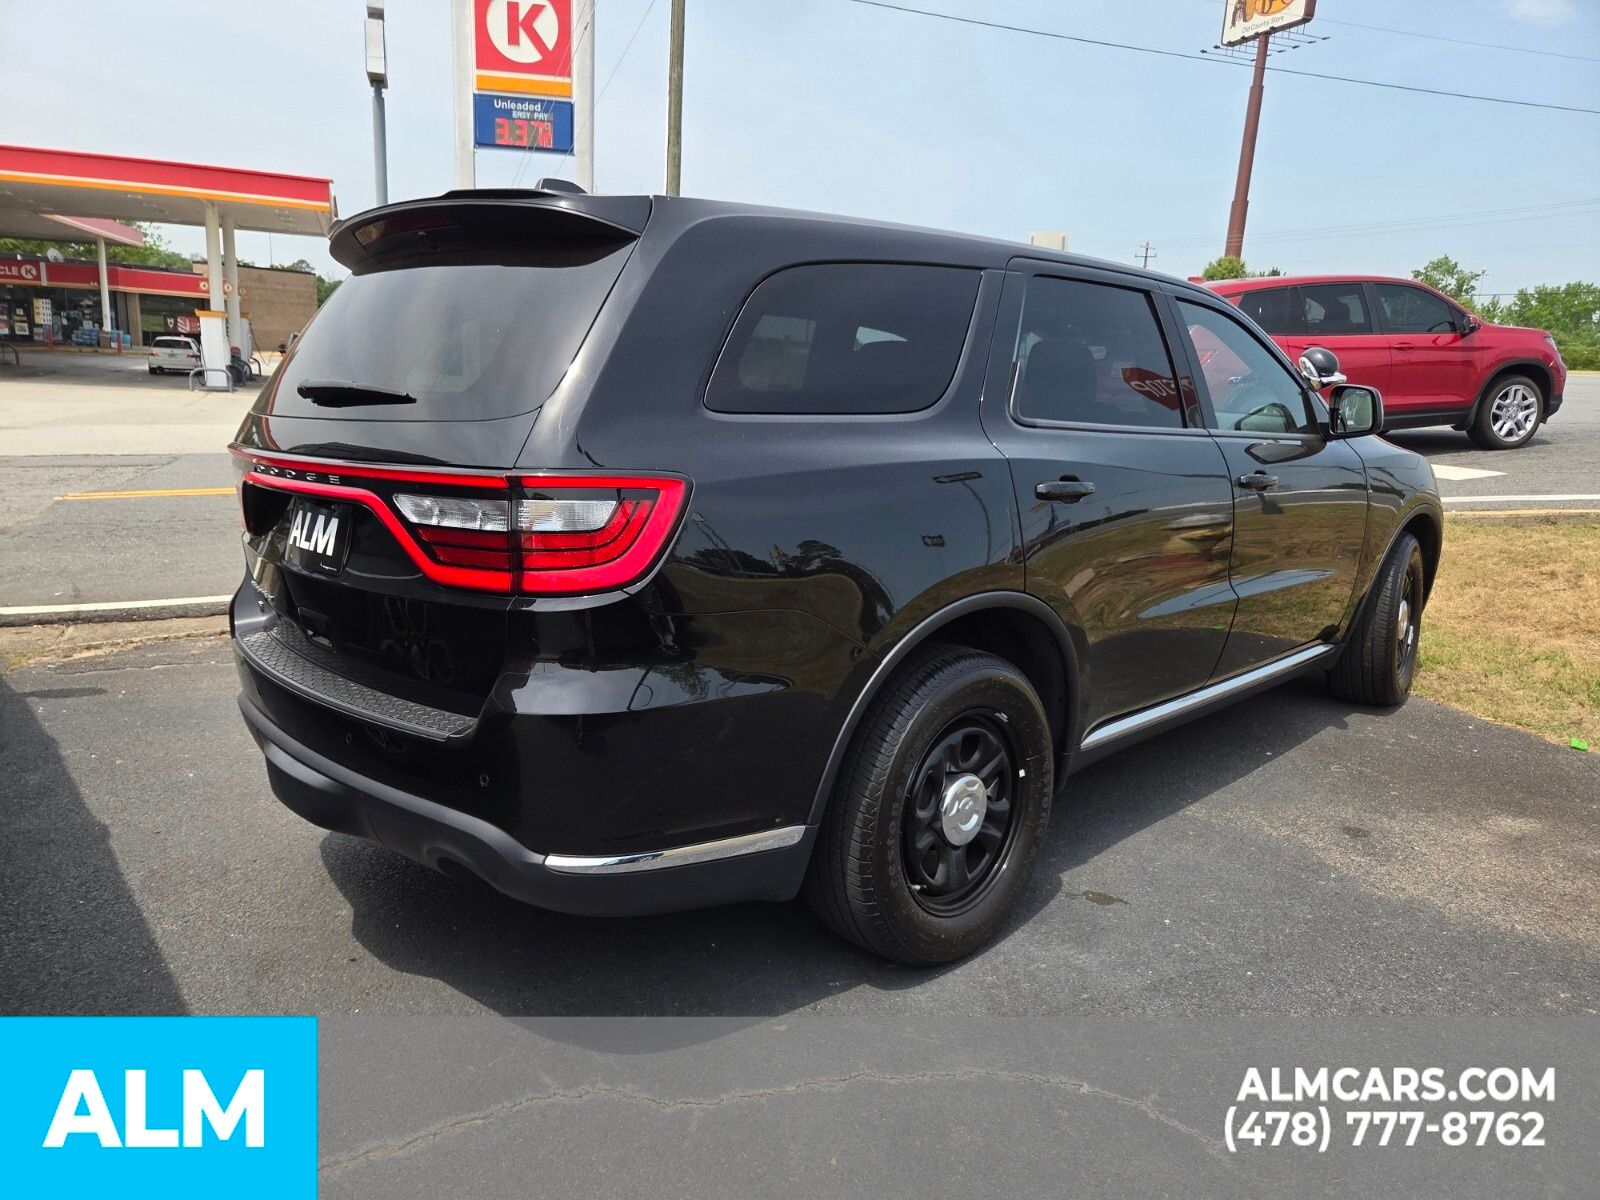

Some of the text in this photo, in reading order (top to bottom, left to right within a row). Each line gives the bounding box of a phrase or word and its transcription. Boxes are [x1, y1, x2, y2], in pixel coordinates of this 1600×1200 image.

[507, 1, 552, 58] K
[494, 98, 541, 112] Unleaded
[512, 110, 531, 119] EASY
[254, 465, 340, 484] DODGE
[289, 510, 339, 556] ALM
